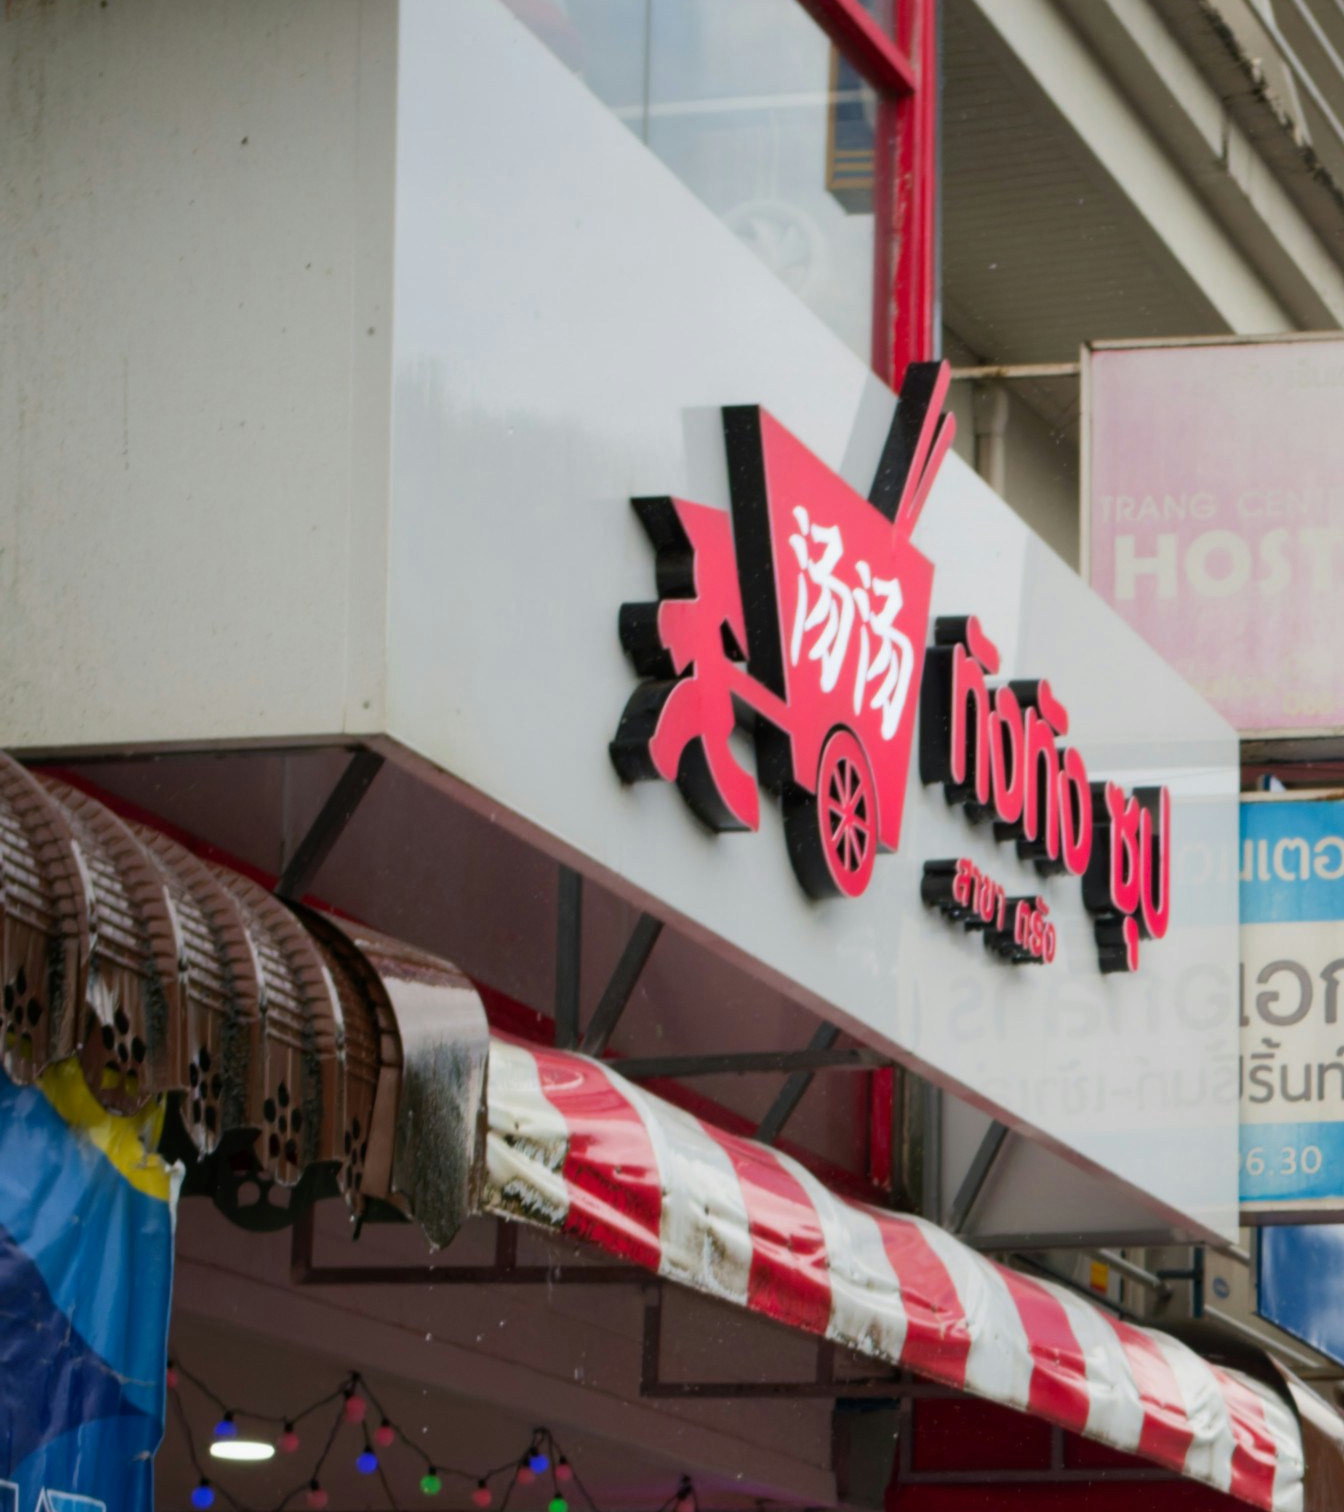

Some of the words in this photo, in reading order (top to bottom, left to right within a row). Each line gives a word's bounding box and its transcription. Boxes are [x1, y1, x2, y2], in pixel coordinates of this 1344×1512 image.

[1098, 490, 1217, 523] TRANG
[953, 857, 1006, 931] สาขา
[1105, 781, 1171, 972] ซุป
[1240, 1145, 1323, 1177] 6.30
